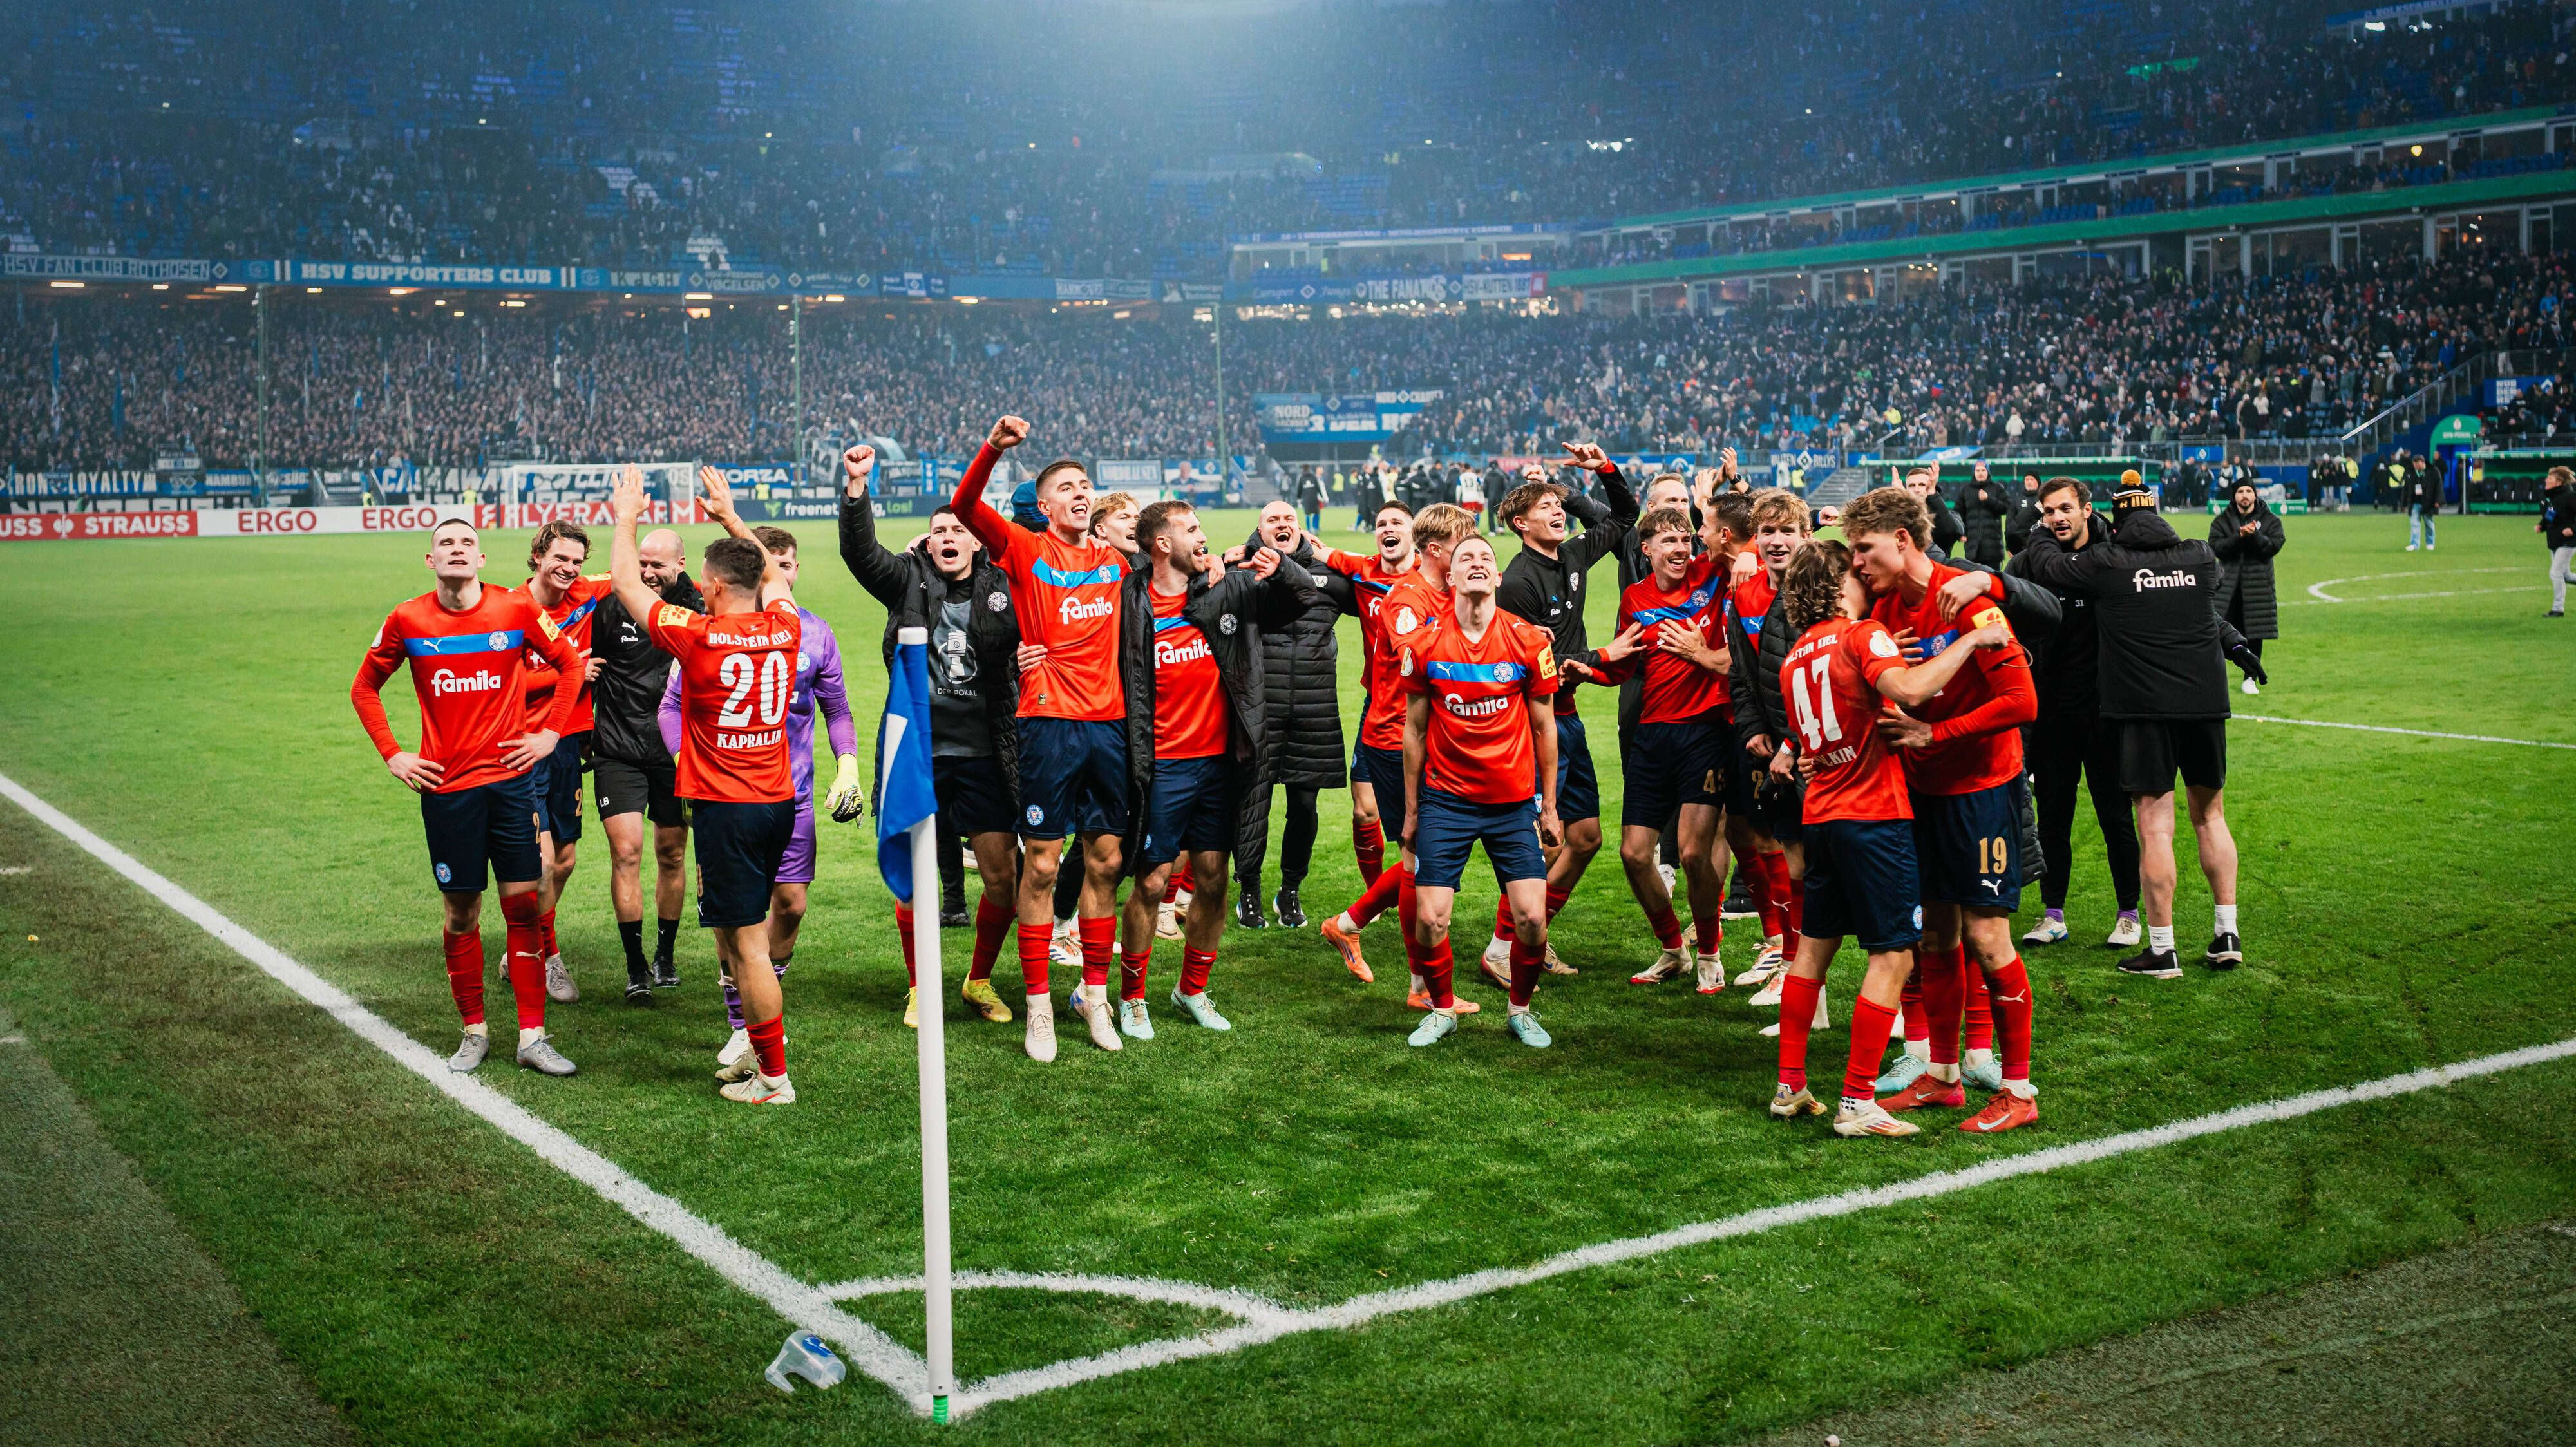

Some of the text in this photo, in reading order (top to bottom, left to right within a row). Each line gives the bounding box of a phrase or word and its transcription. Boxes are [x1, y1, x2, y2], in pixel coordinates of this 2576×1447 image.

[44, 258, 75, 274] FAN
[301, 263, 552, 283] HSV SUPPORTERS CLUB
[1367, 279, 1390, 300] THE
[84, 514, 190, 535] STRAUSS
[238, 509, 317, 533] ERGO
[362, 507, 437, 530] ERGO
[2132, 568, 2197, 592] famila
[1059, 596, 1113, 625] famila
[2075, 599, 2085, 607] 31
[620, 635, 639, 643] famila
[431, 668, 502, 697] famila
[717, 650, 790, 728] 20
[1444, 692, 1509, 717] famila
[1792, 653, 1843, 750] 47
[599, 796, 610, 808] LB
[1978, 837, 2007, 874] 19
